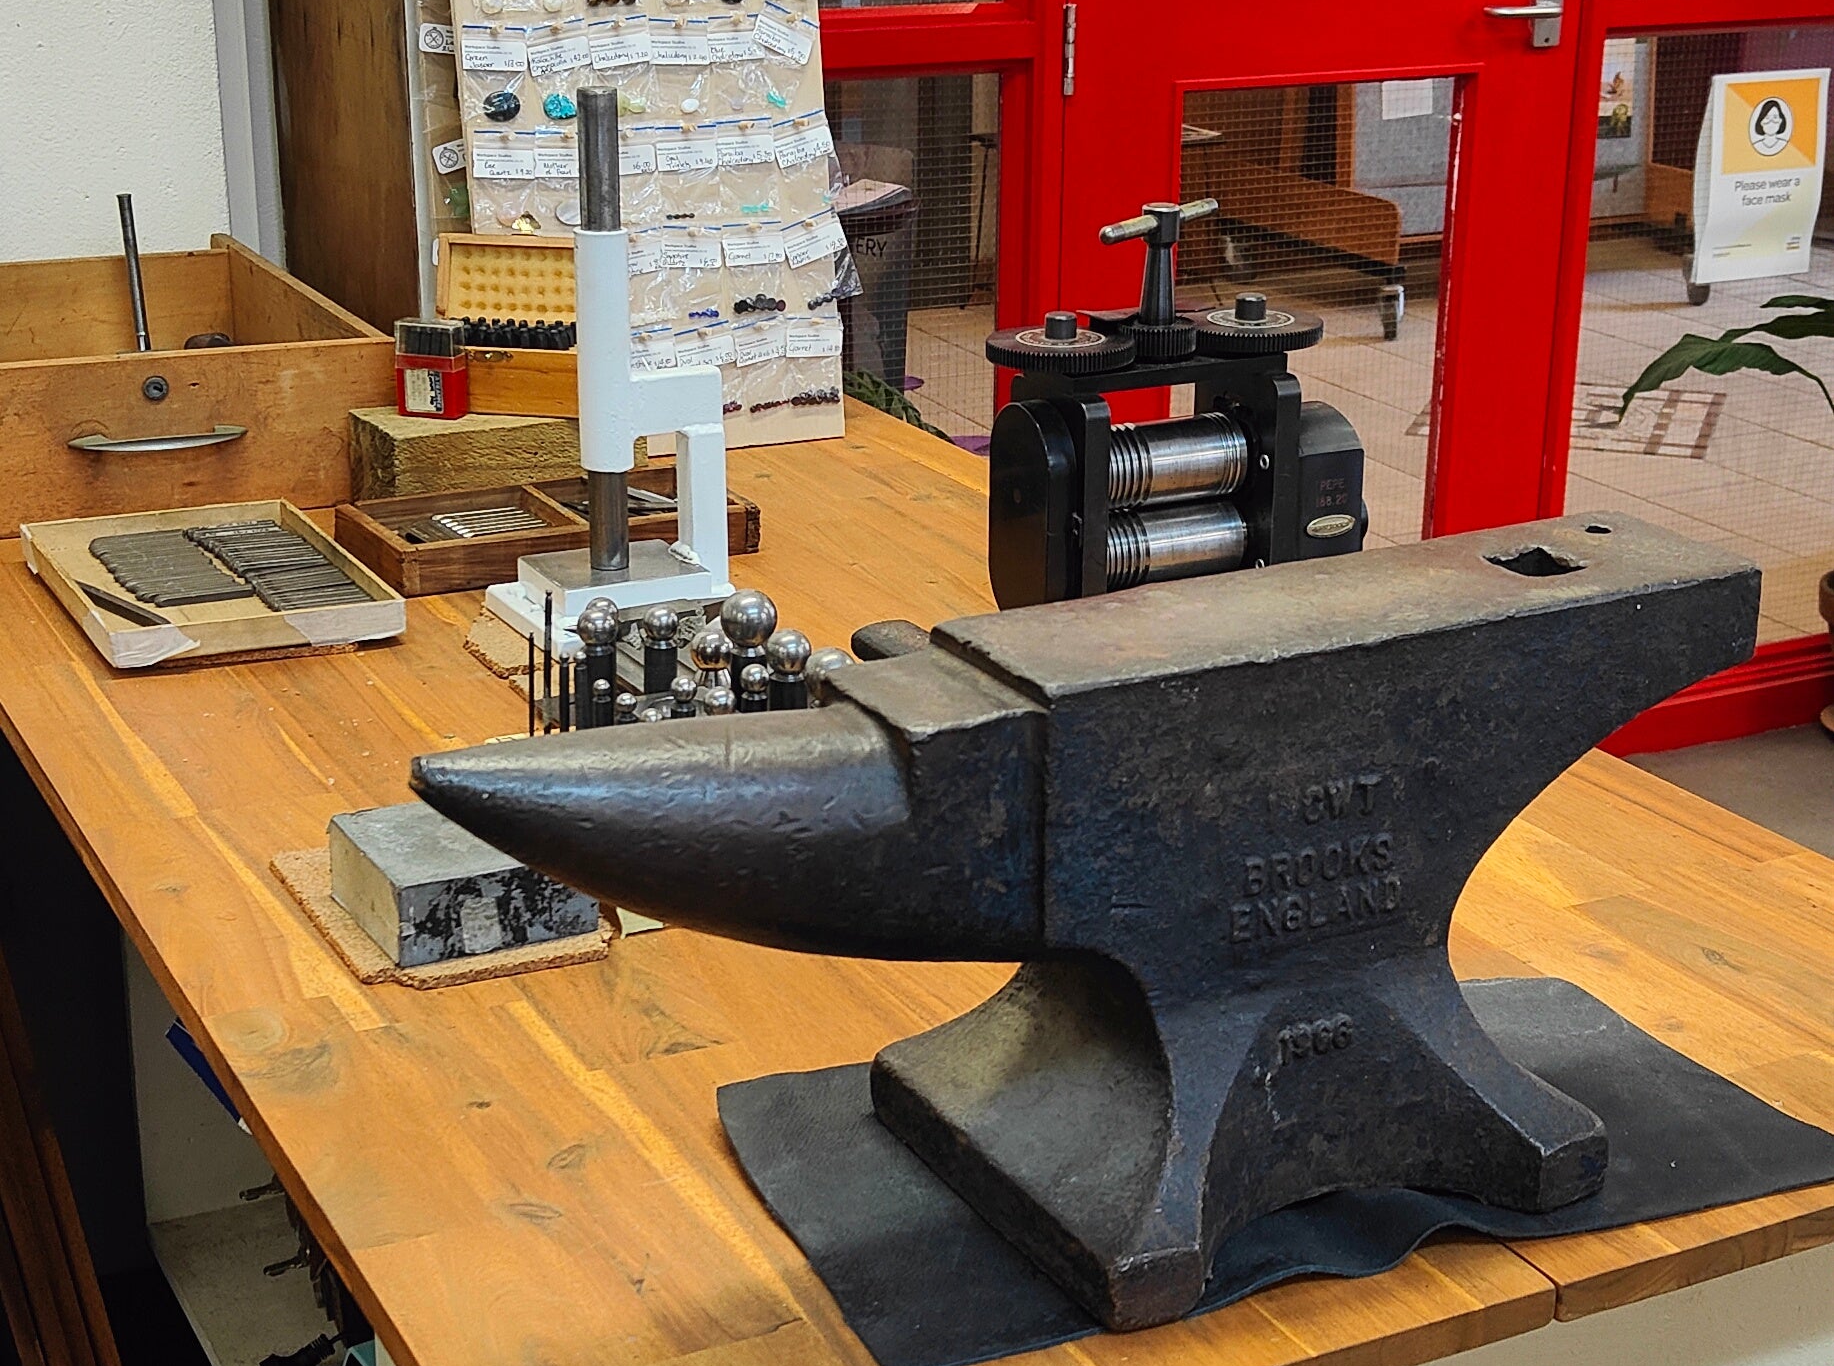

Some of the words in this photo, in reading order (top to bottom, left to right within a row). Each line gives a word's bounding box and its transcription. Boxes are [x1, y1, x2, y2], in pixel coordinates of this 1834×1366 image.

[1735, 180, 1767, 192] Please
[1768, 178, 1793, 189] wear
[1742, 195, 1764, 207] face
[1765, 192, 1792, 204] mask
[1243, 832, 1395, 898] BROOKS
[1229, 874, 1402, 944] ENGLAND
